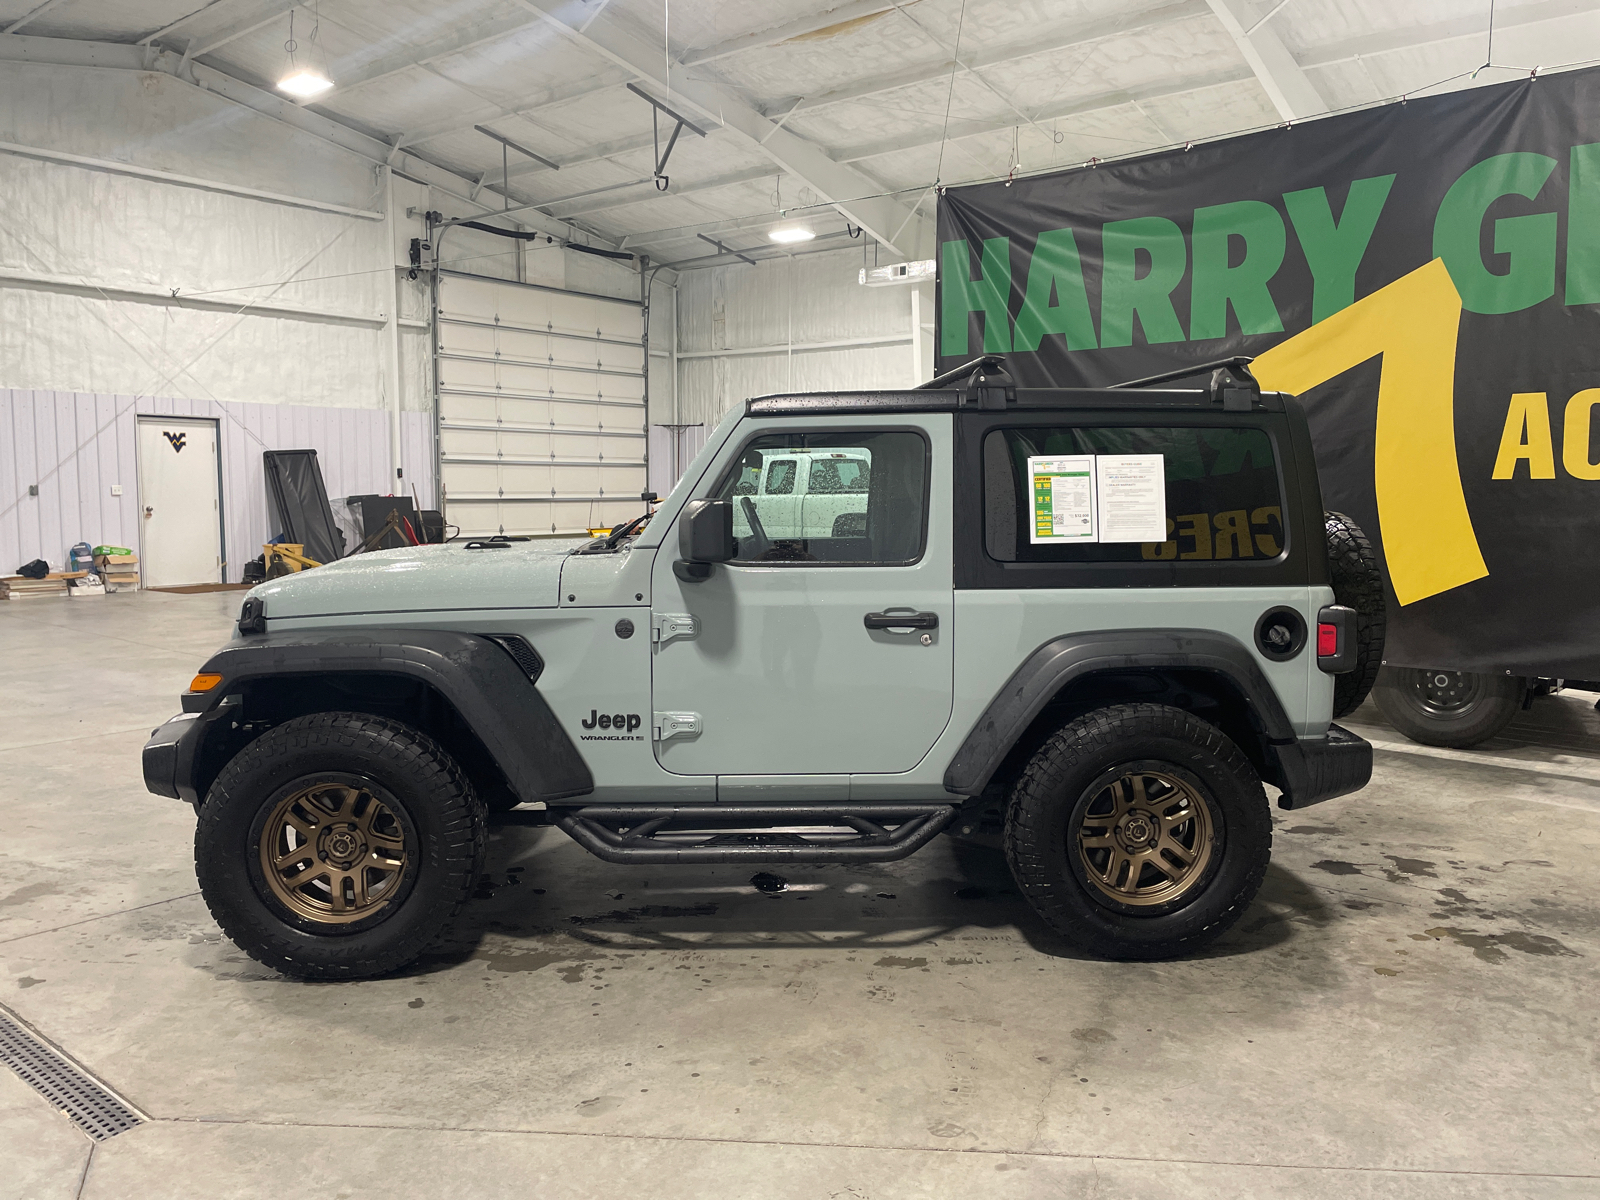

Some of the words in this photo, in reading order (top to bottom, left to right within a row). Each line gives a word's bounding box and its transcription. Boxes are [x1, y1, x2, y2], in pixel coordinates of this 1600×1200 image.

[941, 174, 1396, 357] HARRY
[1249, 257, 1490, 607] 7
[581, 709, 642, 733] Jeep
